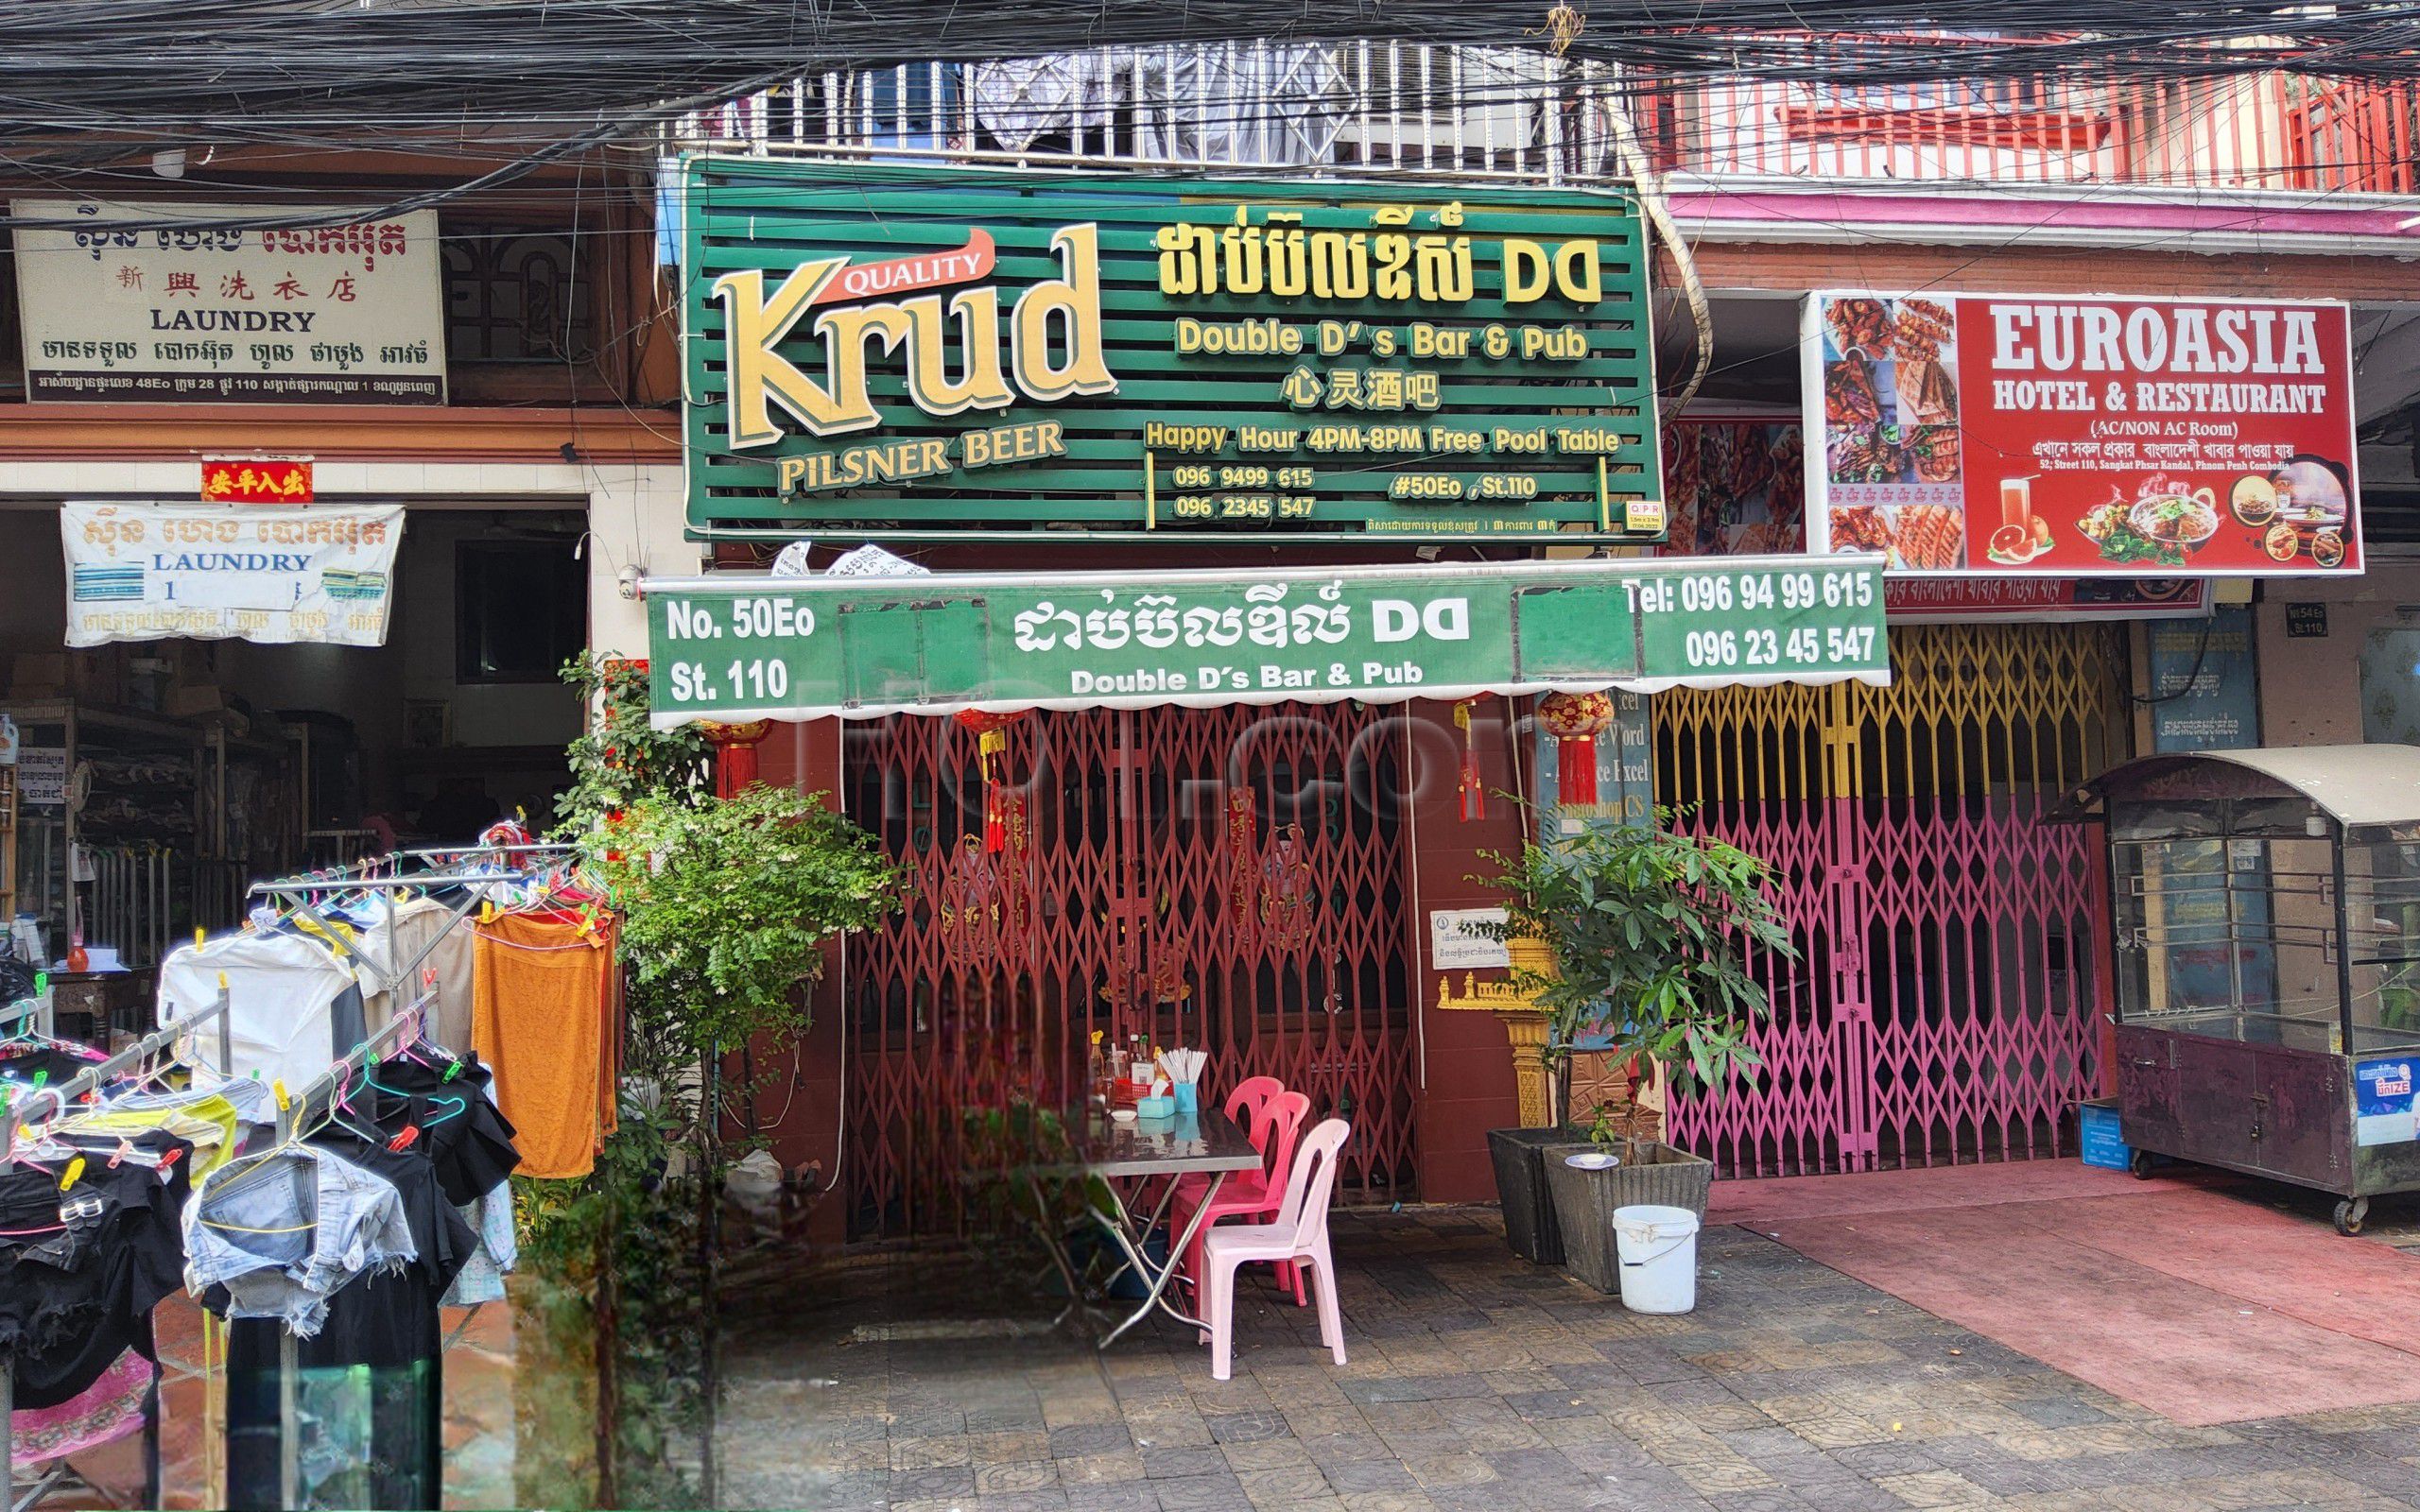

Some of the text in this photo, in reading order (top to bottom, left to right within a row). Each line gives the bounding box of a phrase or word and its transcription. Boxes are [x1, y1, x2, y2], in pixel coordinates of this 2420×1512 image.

[844, 253, 981, 297] QUALITY
[151, 309, 316, 333] LAUNDRY
[712, 222, 1119, 450] Krud
[1178, 318, 1302, 353] Double
[1412, 325, 1470, 358] Bar
[1481, 327, 1510, 356] &
[1521, 327, 1588, 360] Pub
[1990, 304, 2325, 375] EUROASIA
[136, 378, 170, 388] 48Eo
[199, 379, 214, 388] 28
[235, 379, 258, 389] 110
[363, 382, 368, 391] 1
[1285, 367, 1441, 409] 心灵酒吧
[1994, 380, 2326, 414] HOTEL & RESTAURANT
[1146, 422, 1619, 453] Happy Hour 4PM-8PM Free Pool Table
[2090, 420, 2238, 438] (AC/NON AC Room)
[779, 421, 1065, 492] PILSNER BEER
[2055, 459, 2079, 470] Street
[2081, 459, 2098, 471] 110,
[2100, 459, 2134, 472] Sangkat
[2135, 460, 2159, 470] Phsar
[2196, 460, 2224, 471] Phnom
[2226, 460, 2247, 470] Penh
[1175, 467, 1313, 489] 096 9499 615
[1393, 476, 1462, 498] #50Eo
[1175, 497, 1315, 518] 096 2345 547
[152, 554, 312, 572] LAUNDRY
[1682, 576, 1732, 611] 096
[1740, 574, 1774, 610] 94
[1783, 574, 1815, 610] 99
[1823, 572, 1872, 608] 615
[667, 598, 815, 640] No. 50Eo
[1685, 627, 1875, 668] 096 23 45 547
[670, 659, 788, 701] St. 110
[1071, 669, 1186, 694] Double
[1261, 665, 1316, 688] Bar
[1327, 663, 1352, 685] &
[1364, 661, 1423, 684] Pub
[1625, 794, 1644, 817] CS
